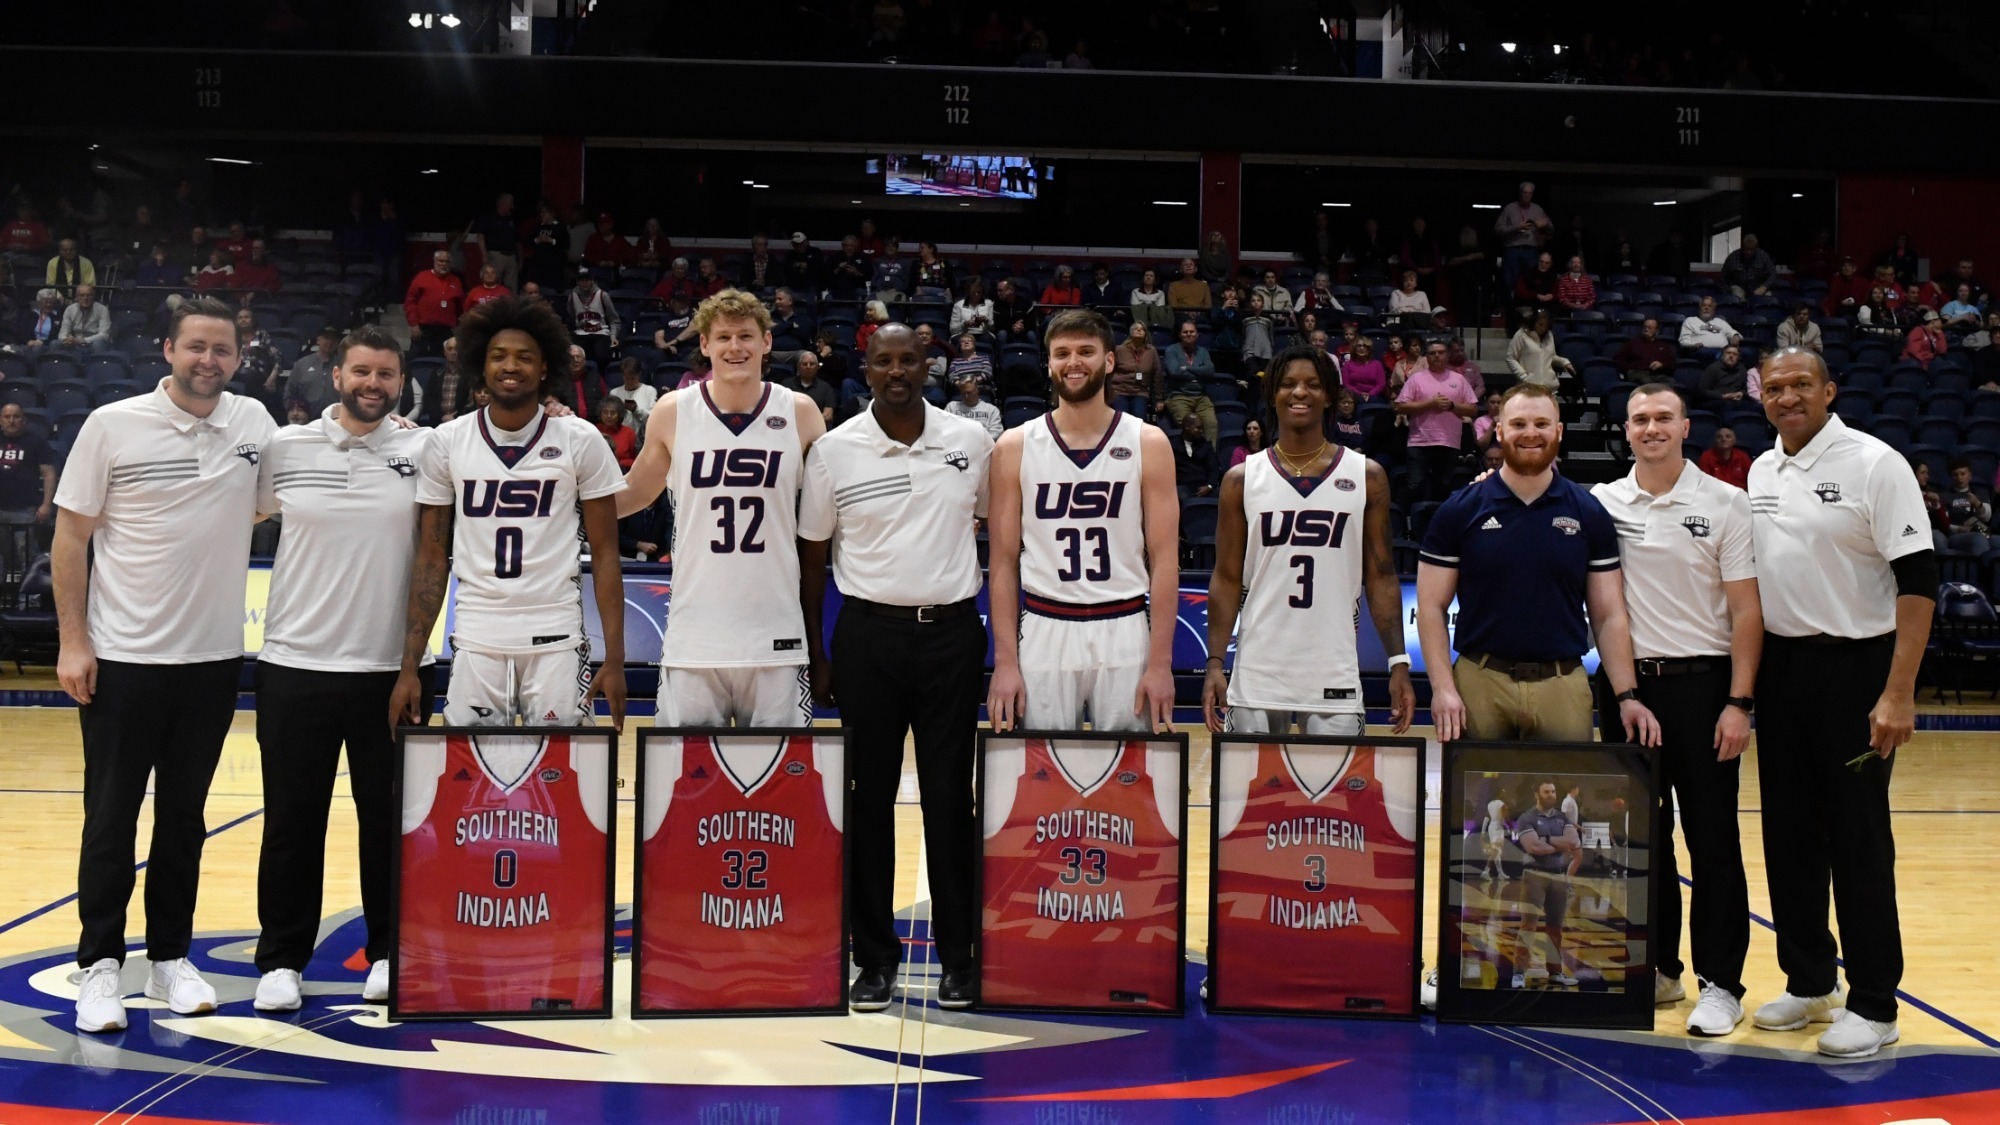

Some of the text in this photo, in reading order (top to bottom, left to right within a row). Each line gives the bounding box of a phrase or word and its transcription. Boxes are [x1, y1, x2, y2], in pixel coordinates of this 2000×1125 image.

[196, 68, 221, 85] 213
[944, 86, 969, 102] 212
[197, 91, 221, 107] 113
[946, 108, 969, 124] 112
[1676, 107, 1700, 123] 211
[1679, 129, 1700, 145] 111
[238, 444, 258, 455] USI
[389, 457, 415, 467] USI
[945, 451, 968, 462] USI
[691, 448, 784, 489] USI
[462, 479, 560, 518] USI
[1035, 481, 1128, 519] USI
[1817, 483, 1839, 494] USI
[711, 496, 765, 553] 32
[1259, 510, 1351, 548] USI
[1685, 516, 1709, 528] USI
[494, 527, 523, 579] 0
[1056, 527, 1110, 581] 33
[1289, 555, 1314, 609] 3
[455, 810, 559, 846] SOUTHERN
[698, 811, 795, 848] SOUTHERN
[1036, 809, 1134, 847] SOUTHERN
[1265, 817, 1364, 854] SOUTHERN
[493, 849, 518, 888] 0
[721, 850, 768, 890] 32
[1059, 847, 1107, 885] 33
[1302, 854, 1325, 892] 3
[457, 892, 550, 928] INDIANA
[702, 892, 784, 930] INDIANA
[1037, 886, 1125, 923] INDIANA
[1268, 894, 1358, 930] INDIANA
